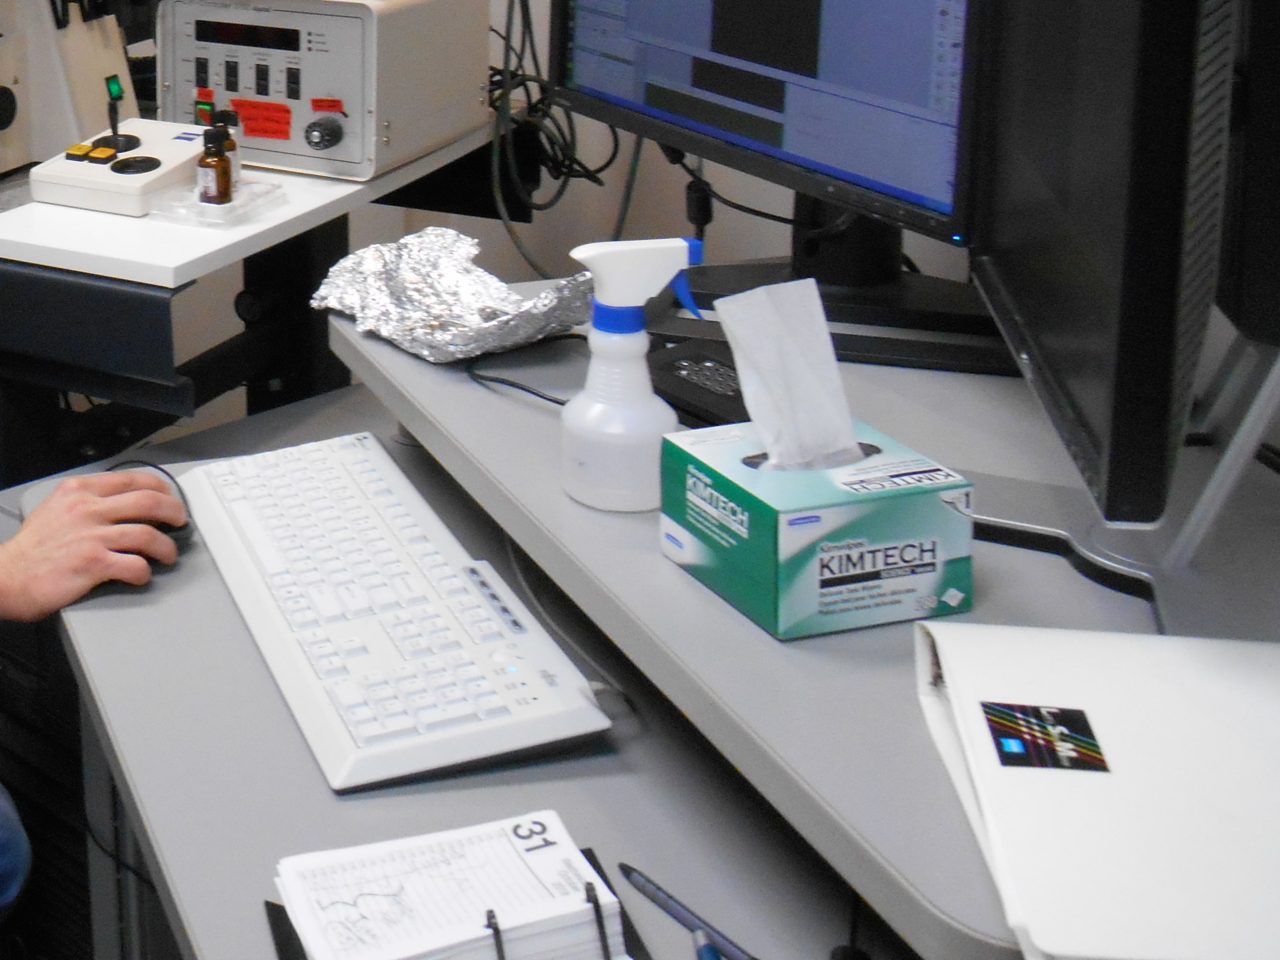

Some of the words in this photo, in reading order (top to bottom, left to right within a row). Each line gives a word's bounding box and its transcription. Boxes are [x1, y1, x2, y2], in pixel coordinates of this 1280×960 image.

[850, 471, 957, 493] KIMTECH
[686, 473, 749, 529] KIMTECH
[819, 540, 937, 578] KIMTECH
[512, 820, 557, 852] 31
